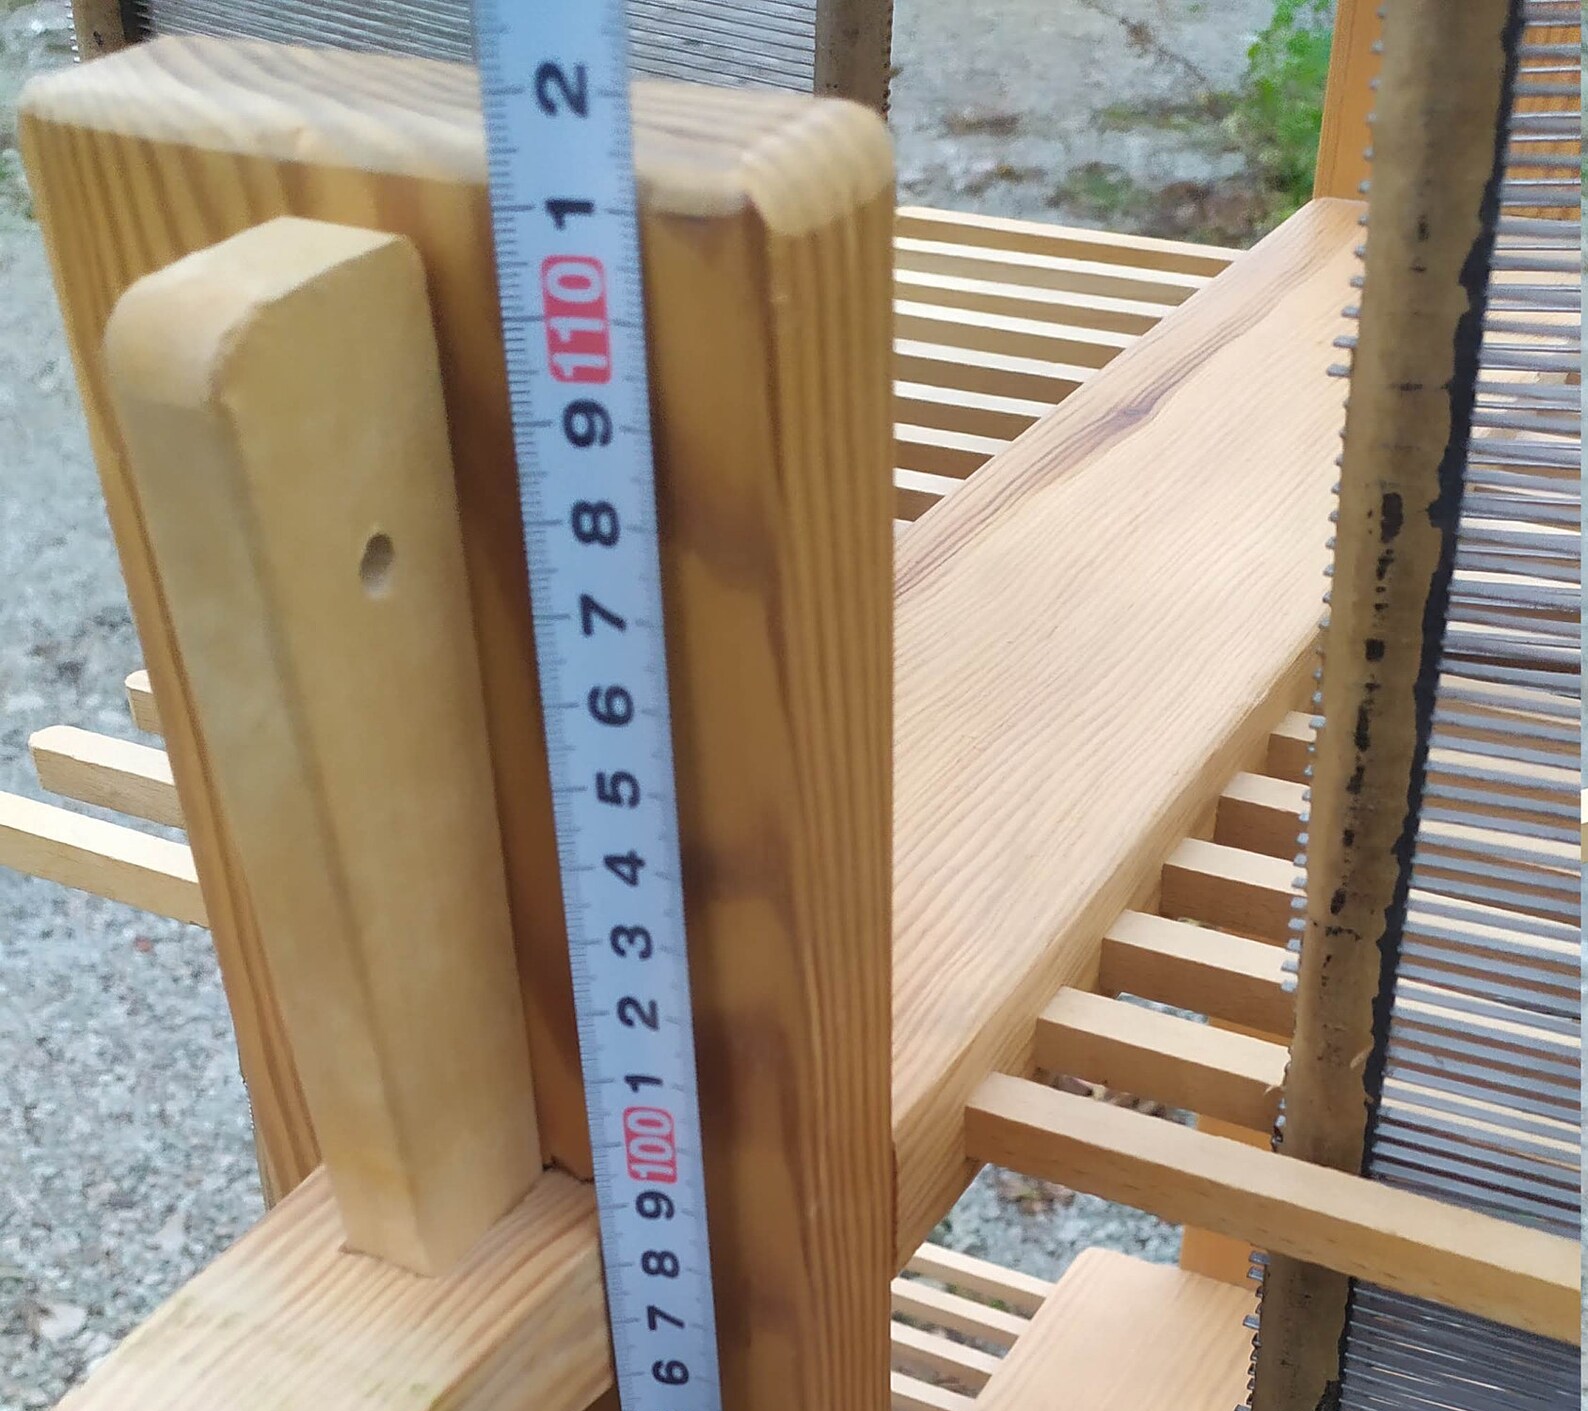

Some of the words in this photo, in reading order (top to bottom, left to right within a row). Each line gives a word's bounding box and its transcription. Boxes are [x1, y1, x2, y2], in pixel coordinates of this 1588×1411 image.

[534, 61, 588, 118] 2
[545, 198, 594, 230] 1
[545, 258, 608, 383] 110
[562, 399, 613, 448] 9
[571, 500, 620, 548] 8
[580, 594, 626, 637] 7
[588, 686, 634, 727] 6
[596, 771, 640, 808] 5
[603, 851, 645, 886] 4
[610, 925, 653, 960] 3
[617, 996, 658, 1030] 2
[624, 1073, 663, 1093] 1
[625, 1107, 677, 1183] 100
[636, 1190, 675, 1219] 9
[641, 1250, 680, 1278] 8
[647, 1305, 684, 1331] 7
[652, 1360, 689, 1385] 6
